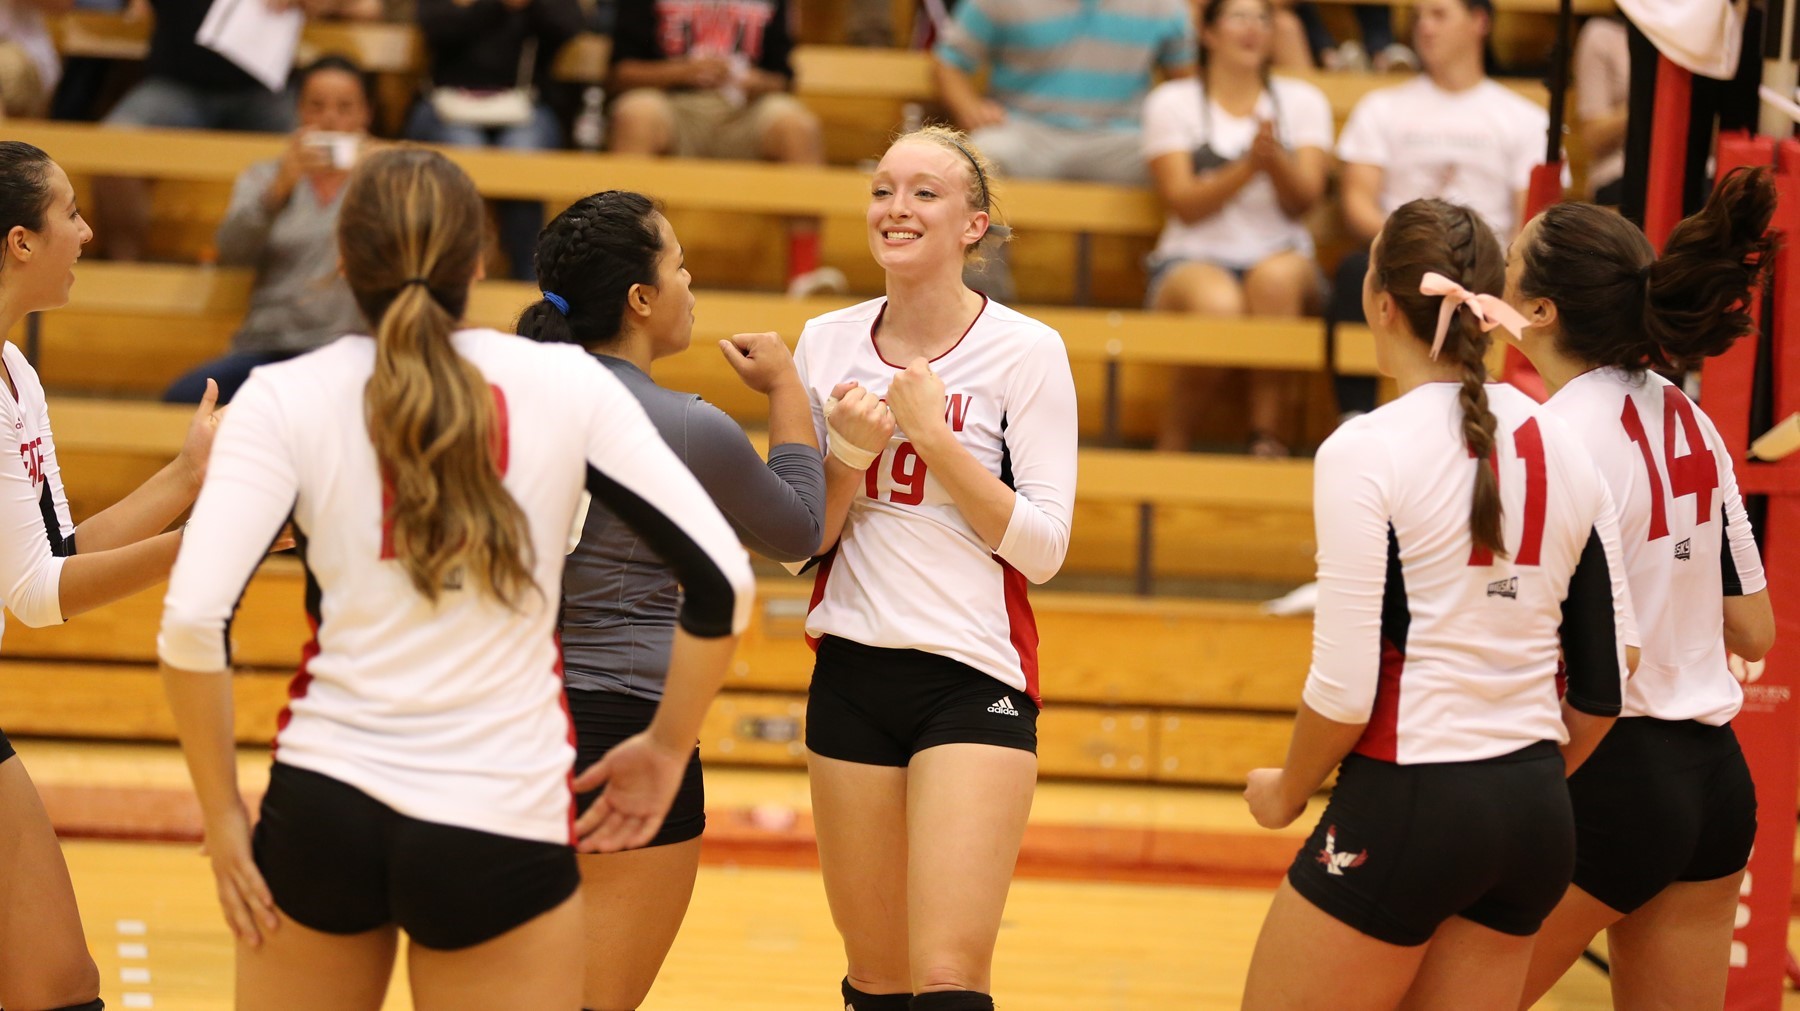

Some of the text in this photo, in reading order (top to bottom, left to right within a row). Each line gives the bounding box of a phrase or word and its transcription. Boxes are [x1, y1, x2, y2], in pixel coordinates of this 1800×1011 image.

[866, 441, 928, 506] 19
[1620, 385, 1718, 541] 14
[987, 706, 1019, 717] adidas
